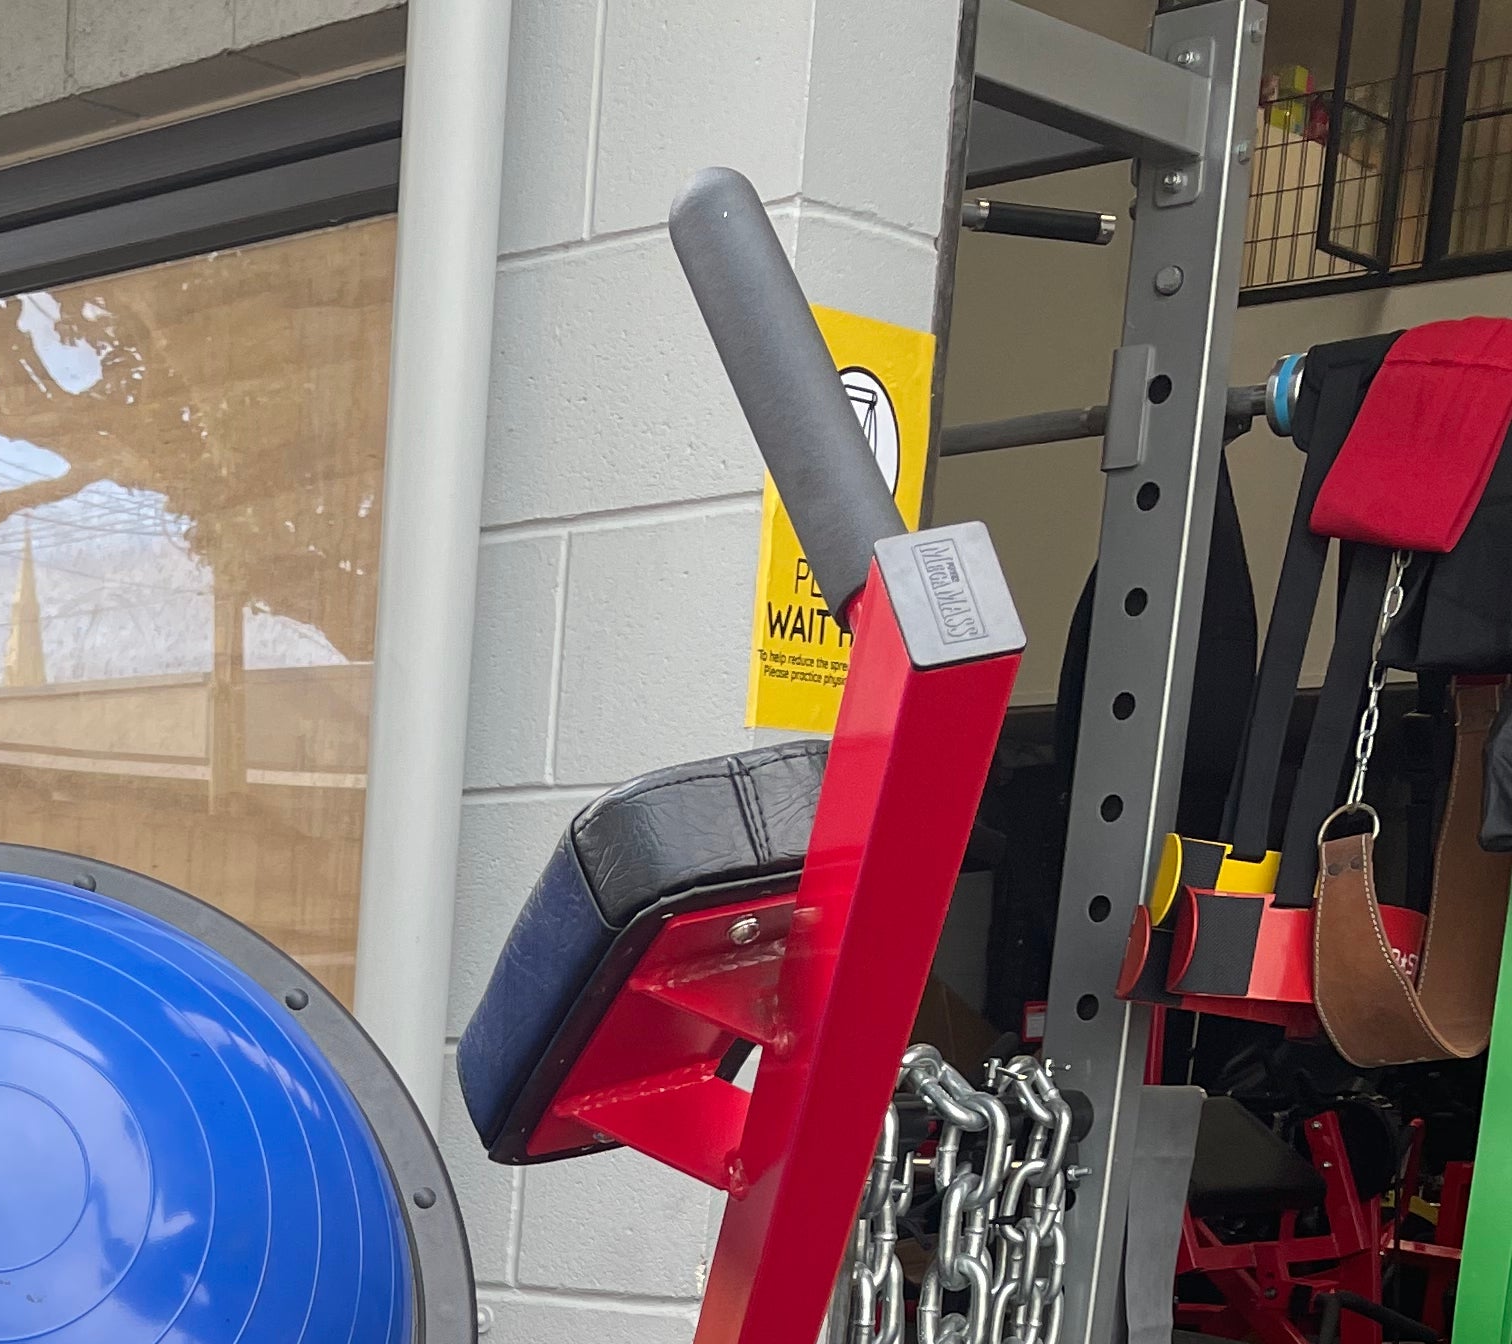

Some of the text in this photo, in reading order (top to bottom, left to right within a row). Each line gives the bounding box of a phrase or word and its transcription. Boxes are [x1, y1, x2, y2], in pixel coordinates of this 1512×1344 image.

[768, 601, 832, 645] WAIT
[757, 648, 848, 672] To help reduce the spre
[764, 664, 789, 679] Please
[790, 670, 823, 683] practice
